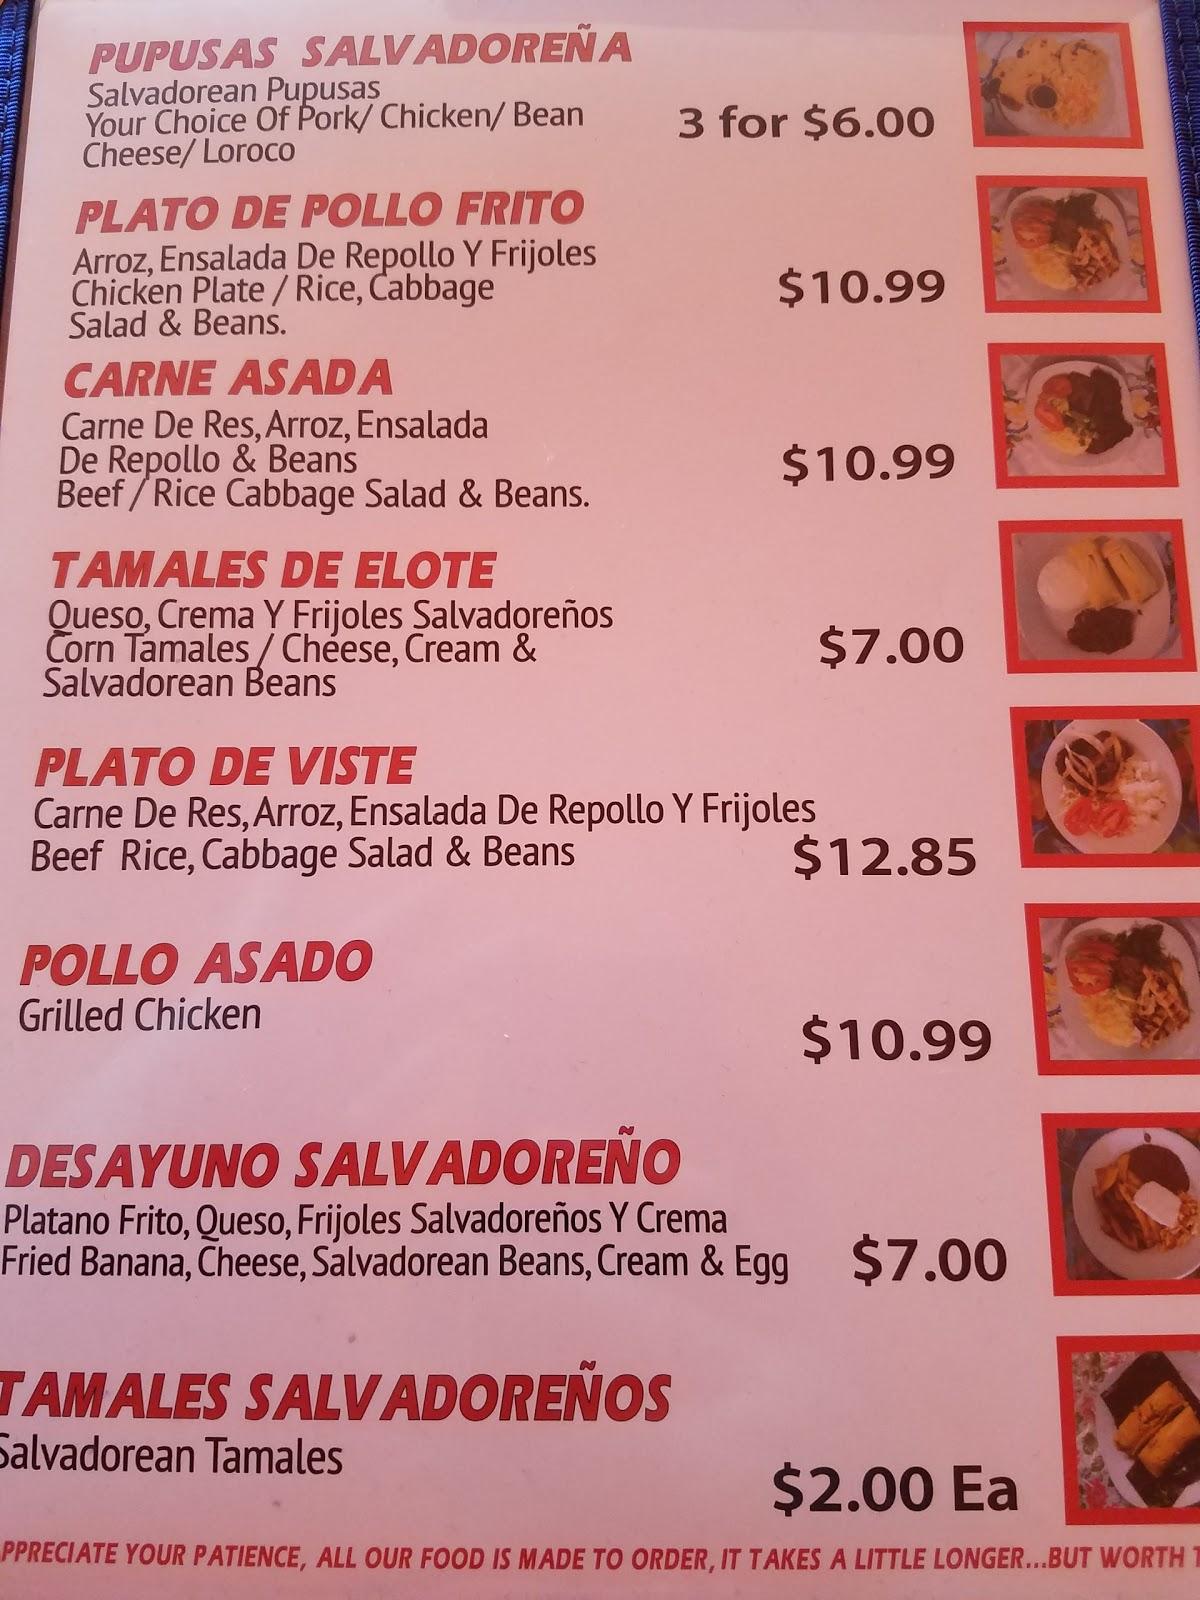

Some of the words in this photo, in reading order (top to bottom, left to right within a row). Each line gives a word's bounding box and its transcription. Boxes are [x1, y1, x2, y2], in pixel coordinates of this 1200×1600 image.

[89, 37, 277, 74] PUPUSAS
[302, 23, 632, 67] SALVADOREÑA
[87, 80, 256, 108] Salvadorean
[267, 77, 380, 105] Pupusas
[86, 112, 146, 137] Your
[155, 108, 246, 135] Choice
[257, 106, 291, 132] Of
[514, 101, 583, 126] Bean
[679, 108, 704, 139] 3
[719, 105, 788, 138] for
[804, 104, 934, 141] $6.00
[204, 138, 295, 163] Loroco
[75, 196, 219, 234] PLATO
[232, 195, 291, 229] DE
[301, 192, 442, 228] POLLO
[456, 190, 584, 225] FRITO
[72, 248, 153, 277] Arroz,
[161, 243, 286, 272] Ensalada
[298, 242, 335, 269] De
[346, 240, 454, 277] Repollo
[463, 240, 483, 267] Y
[492, 239, 596, 274] Frijoles
[72, 278, 182, 307] Chicken
[193, 276, 264, 303] Plate
[297, 273, 362, 306] Rice,
[370, 272, 494, 308] Cabbage
[779, 267, 945, 308] $10.99
[69, 310, 147, 339] Salad
[159, 309, 181, 337] &
[194, 308, 286, 336] Beans.
[64, 360, 217, 398] CARNE
[228, 359, 392, 395] ASADA
[62, 412, 144, 440] Carne
[155, 410, 193, 439] De
[204, 410, 261, 443] Res,
[265, 410, 350, 443] Arroz,
[358, 410, 488, 439] Ensalada
[60, 446, 98, 474] De
[109, 444, 220, 479] Repollo
[233, 443, 256, 473] &
[269, 444, 357, 473] Beans
[783, 444, 954, 487] $10.99
[58, 478, 125, 508] Beef
[155, 478, 215, 507] Rice
[226, 478, 354, 515] Cabbage
[365, 478, 445, 508] Salad
[459, 479, 482, 508] &
[496, 479, 589, 508] Beans.
[52, 550, 268, 588] TAMALES
[281, 551, 343, 588] DE
[355, 551, 497, 589] ELOTE
[49, 600, 150, 635] Queso,
[158, 599, 254, 629] Crema
[264, 600, 285, 628] Y
[294, 600, 403, 637] Frijoles
[413, 599, 613, 629] Salvadoreños
[46, 630, 114, 663] Corn
[124, 631, 249, 663] Tamales
[282, 633, 398, 668] Cheese,
[405, 633, 499, 663] Cream
[513, 632, 536, 662] &
[820, 625, 963, 669] $7.00
[43, 667, 233, 697] Salvadorean
[246, 664, 336, 697] Beans
[35, 747, 195, 787] PLATO
[209, 747, 275, 785] DE
[288, 746, 417, 785] VISTE
[34, 797, 123, 829] Carne
[135, 797, 176, 828] De
[188, 796, 249, 832] Res,
[253, 796, 343, 832] Arroz,
[351, 795, 486, 826] Ensalada
[499, 794, 538, 825] De
[550, 793, 664, 832] Repollo
[672, 793, 693, 823] Y
[703, 792, 816, 831] Frijoles
[32, 839, 105, 871] Beef
[122, 839, 194, 875] Rice,
[202, 838, 337, 877] Cabbage
[348, 836, 432, 868] Salad
[446, 835, 471, 867] &
[484, 835, 575, 866] Beans
[794, 834, 976, 880] $12.85
[20, 943, 178, 986] POLLO
[194, 940, 373, 984] ASADO
[19, 998, 123, 1032] Grilled
[135, 997, 260, 1031] Chicken
[802, 1014, 991, 1064] $10.99
[5, 1143, 279, 1189] DESAYUNO
[294, 1126, 681, 1188] SALVADOREÑO
[4, 1204, 110, 1235] Platano
[120, 1204, 190, 1240] Frito,
[196, 1204, 291, 1242] Queso,
[298, 1203, 401, 1243] Frijoles
[410, 1201, 601, 1234] Salvadoreños
[609, 1201, 629, 1232] Y
[637, 1201, 727, 1233] Crema
[2, 1245, 71, 1276] Fried
[81, 1245, 191, 1282] Banana,
[198, 1245, 306, 1282] Cheese,
[312, 1245, 488, 1277] Salvadorean
[500, 1244, 591, 1281] Beans,
[598, 1244, 688, 1276] Cream
[701, 1244, 724, 1276] &
[736, 1245, 788, 1285] Egg
[853, 1233, 1007, 1286] $7.00
[0, 1371, 231, 1420] TAMALES
[245, 1360, 671, 1422] SALVADOREÑOS
[205, 1437, 343, 1475] Tamales
[773, 1462, 933, 1517] $2.00
[953, 1465, 1018, 1511] Ea
[126, 1543, 186, 1565] YOUR
[194, 1545, 306, 1571] PATIENCE,
[316, 1546, 356, 1568] ALL
[365, 1547, 413, 1569] OUR
[420, 1547, 485, 1570] FOOD
[493, 1548, 511, 1570] IS
[518, 1548, 586, 1570] MADE
[593, 1548, 623, 1570] TO
[632, 1548, 715, 1573] ORDER,
[721, 1548, 742, 1570] IT
[749, 1548, 821, 1570] TAKES
[829, 1548, 847, 1570] A
[855, 1548, 926, 1570] LITTLE
[1100, 1546, 1184, 1568] WORTH
